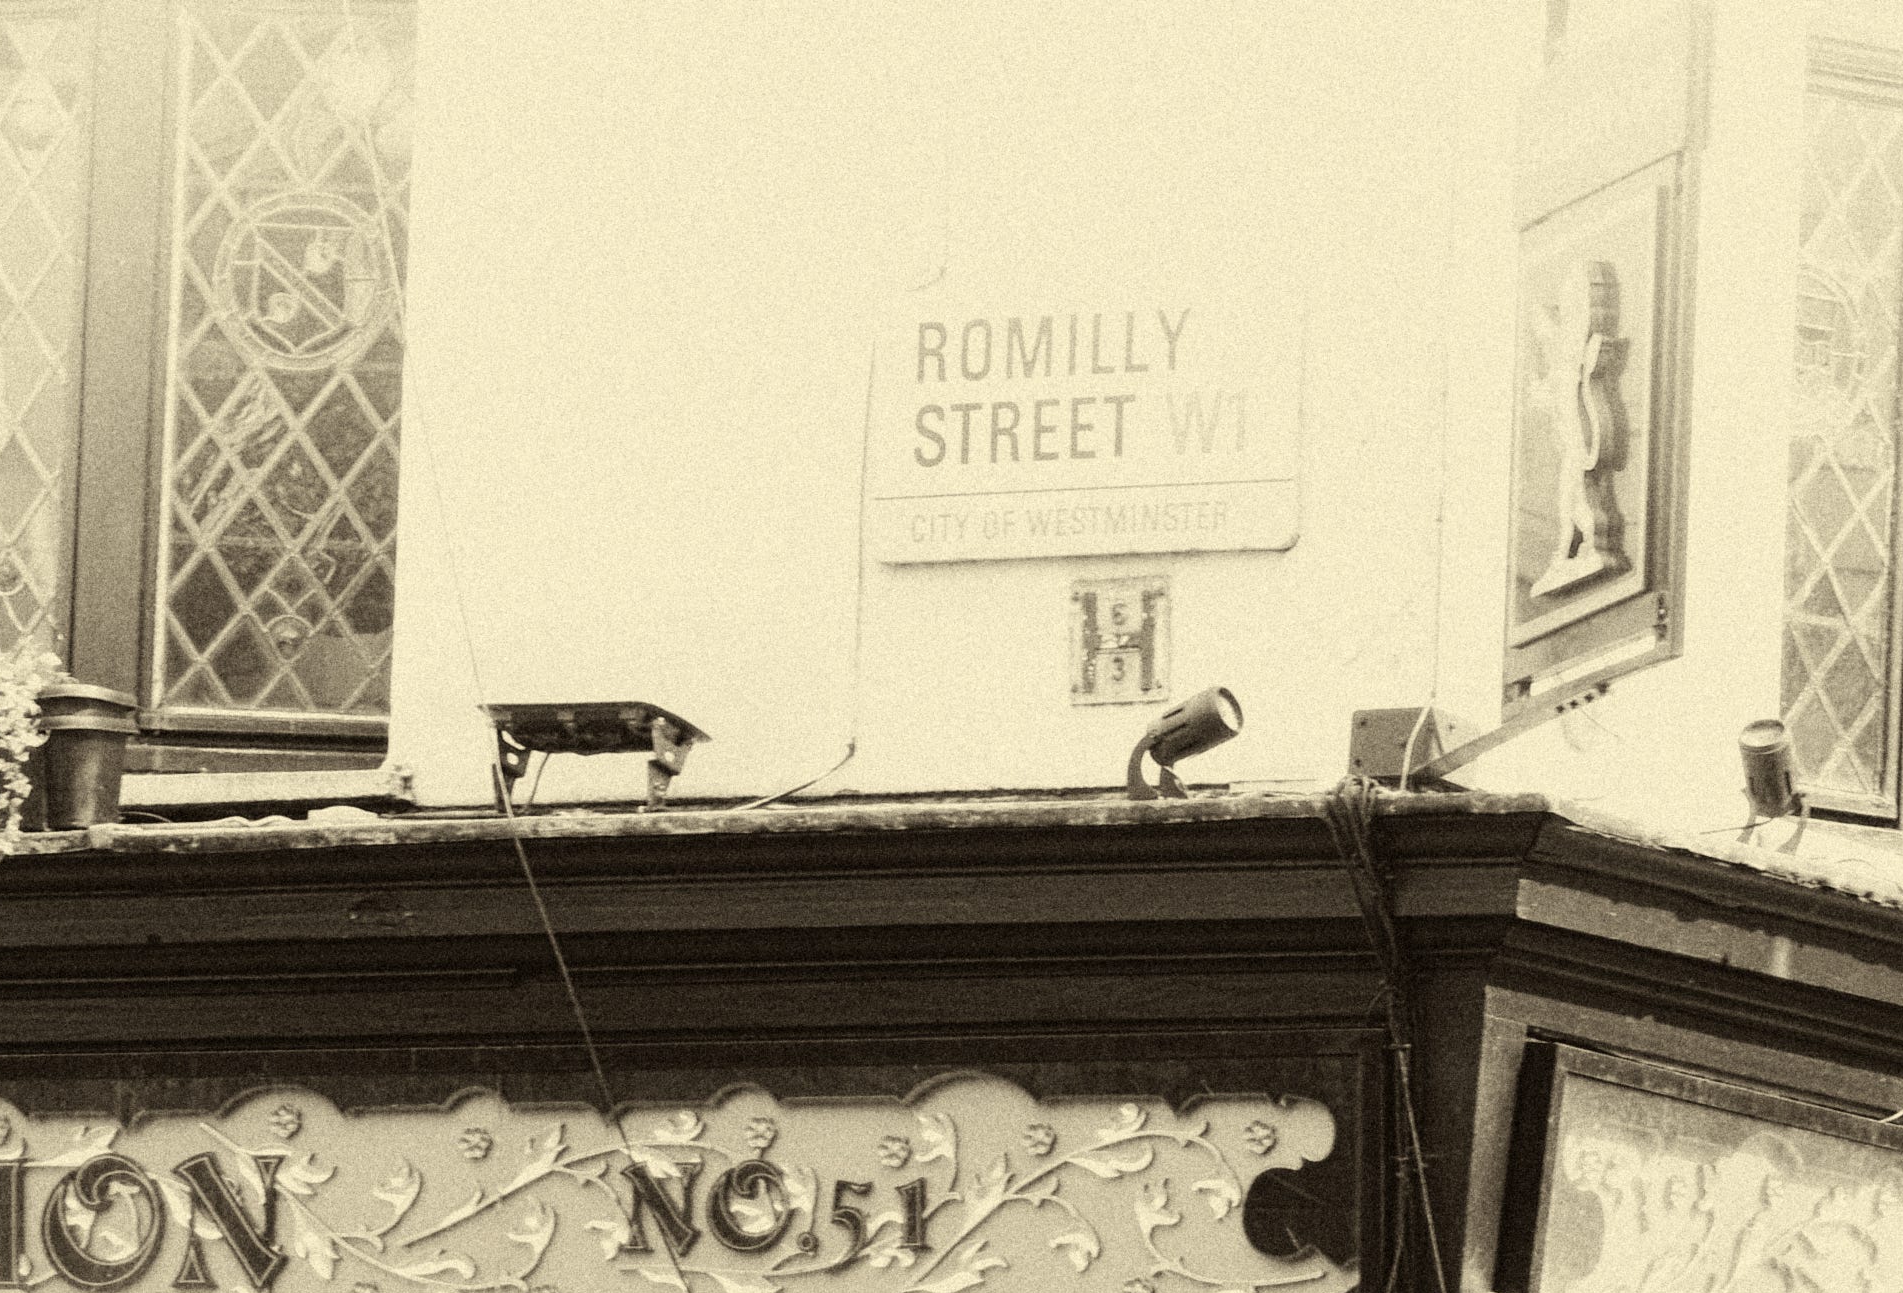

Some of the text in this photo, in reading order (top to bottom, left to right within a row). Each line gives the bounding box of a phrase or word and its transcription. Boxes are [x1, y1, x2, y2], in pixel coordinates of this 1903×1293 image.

[915, 307, 1191, 384] ROMILLY
[913, 389, 1248, 468] STREET W1
[910, 500, 1229, 543] CITY OF WESTMINSTER
